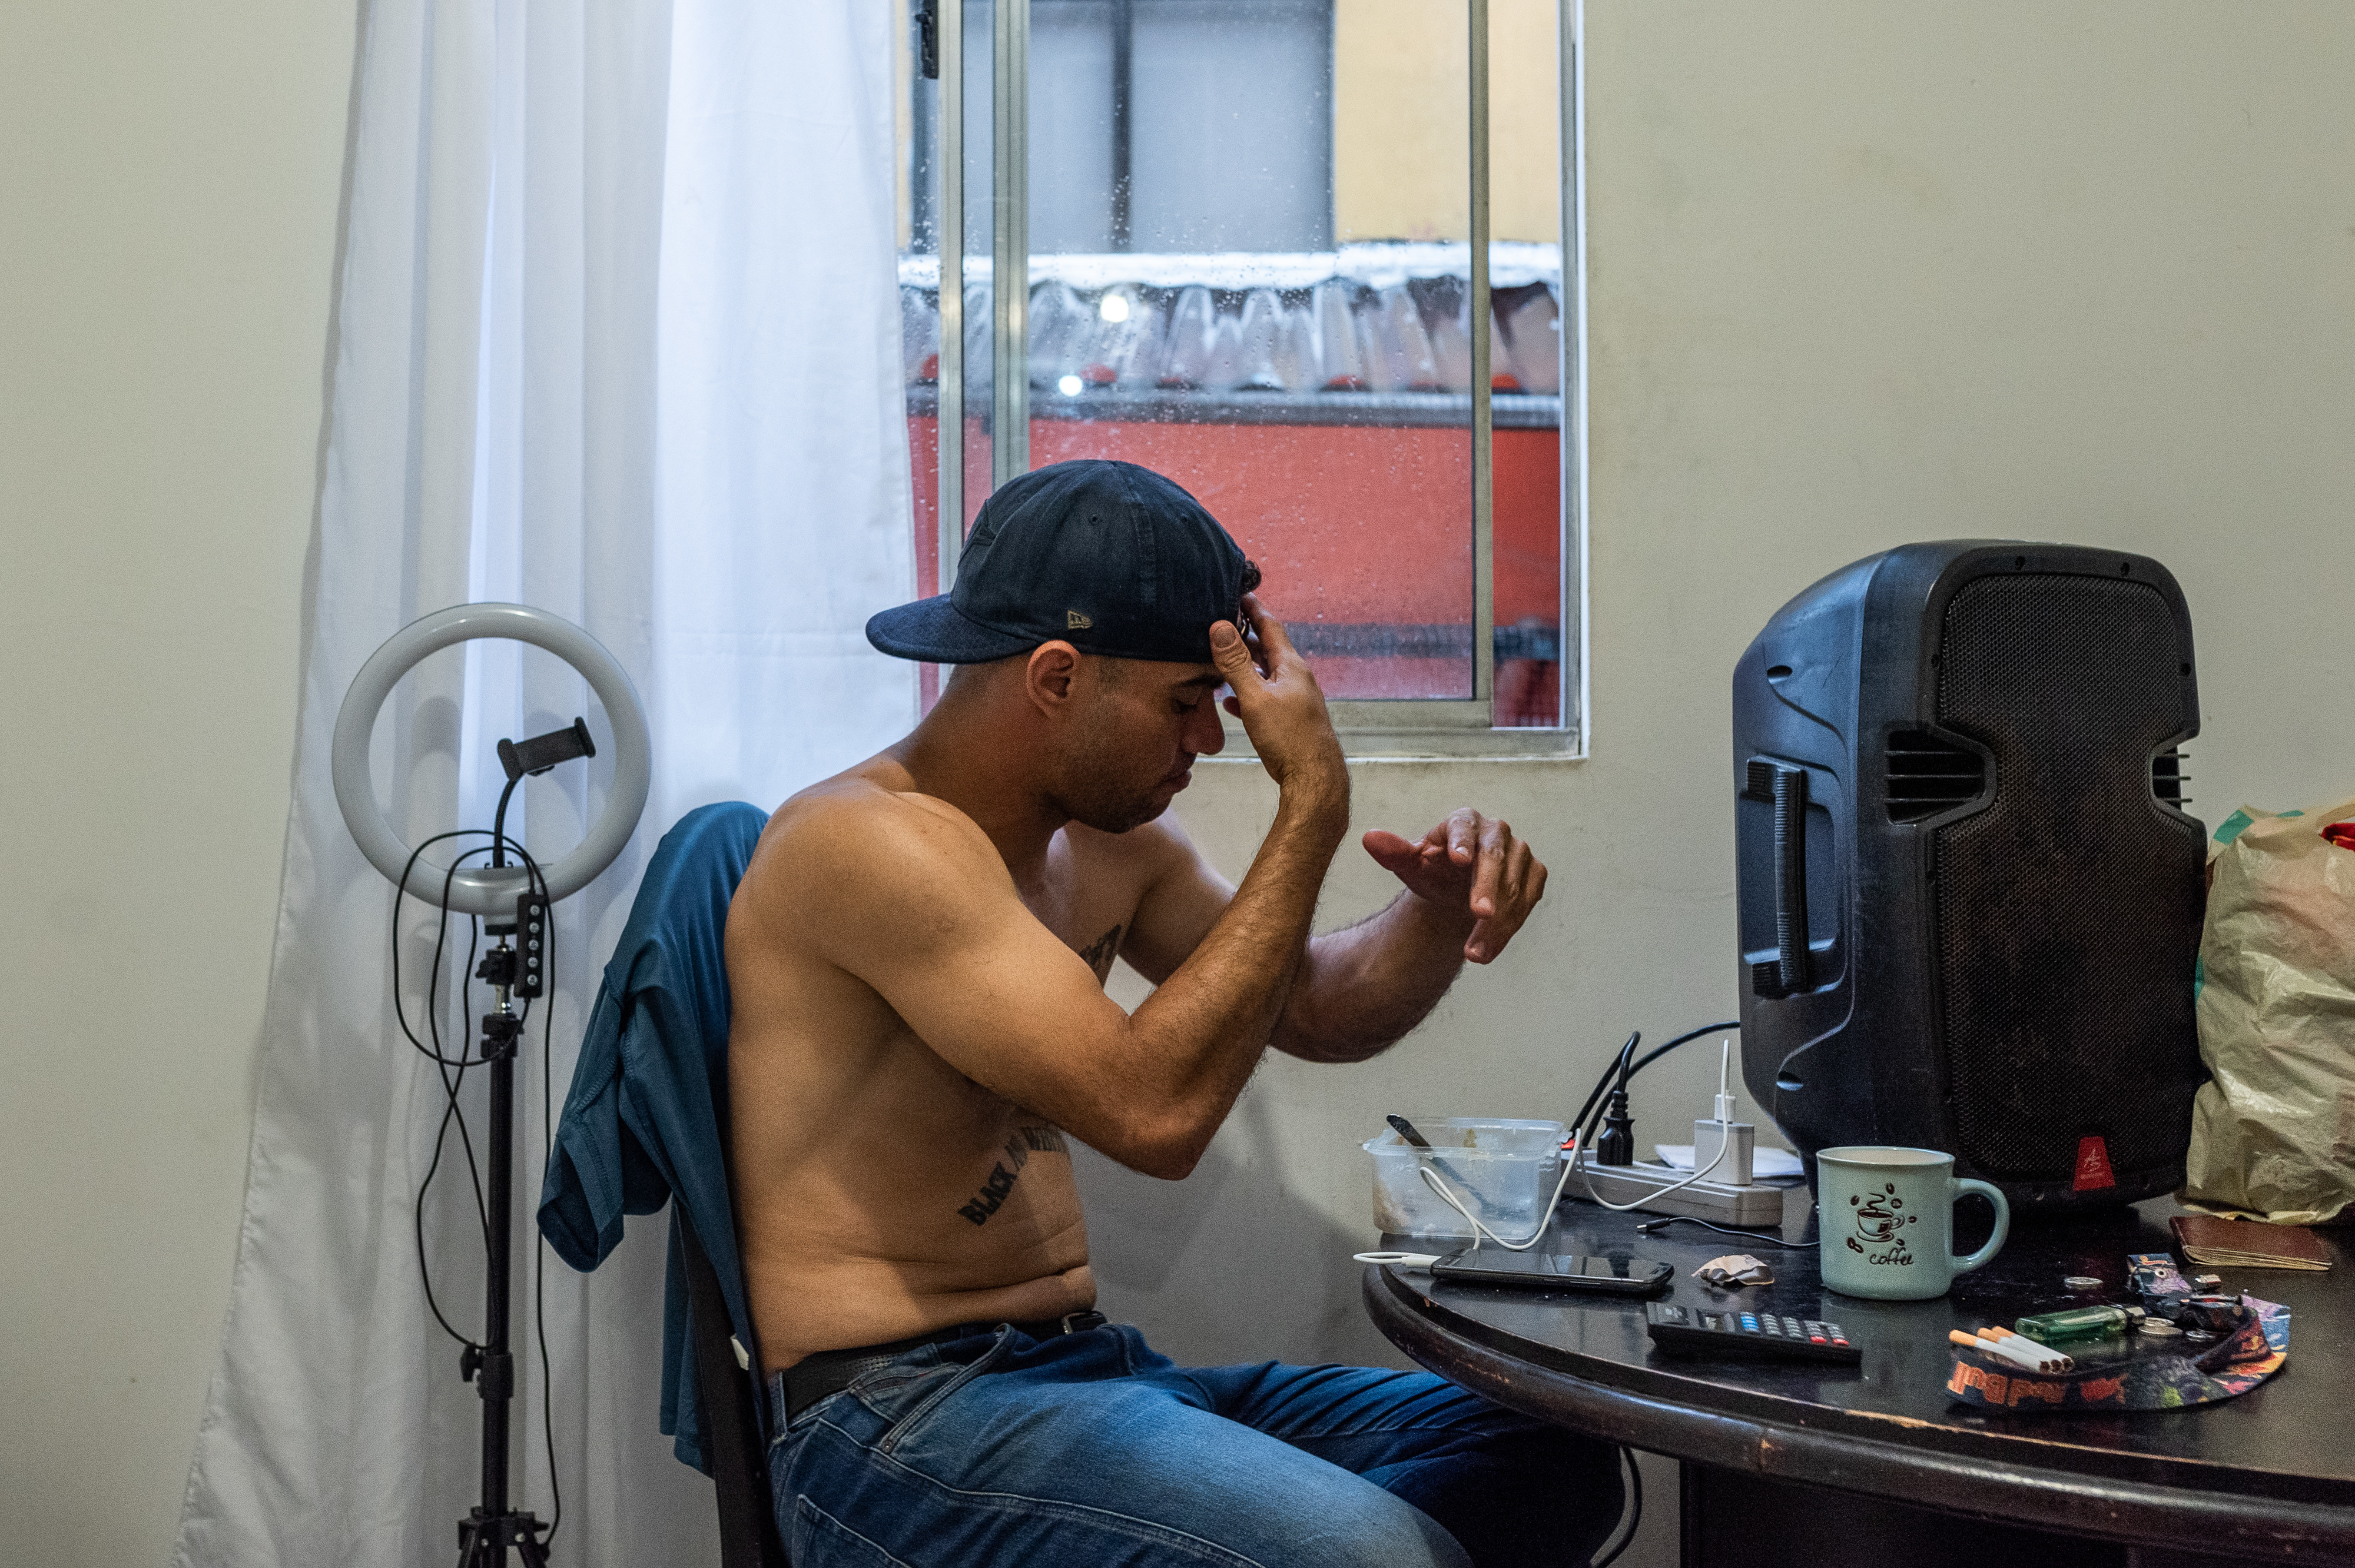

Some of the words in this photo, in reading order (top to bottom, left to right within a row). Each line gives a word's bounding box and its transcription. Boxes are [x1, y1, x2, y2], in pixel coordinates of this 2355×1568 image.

[957, 1161, 1017, 1225] BLACK
[1869, 1247, 1914, 1266] coffee
[1946, 1360, 2008, 1404] Bull
[2008, 1378, 2068, 1407] Red
